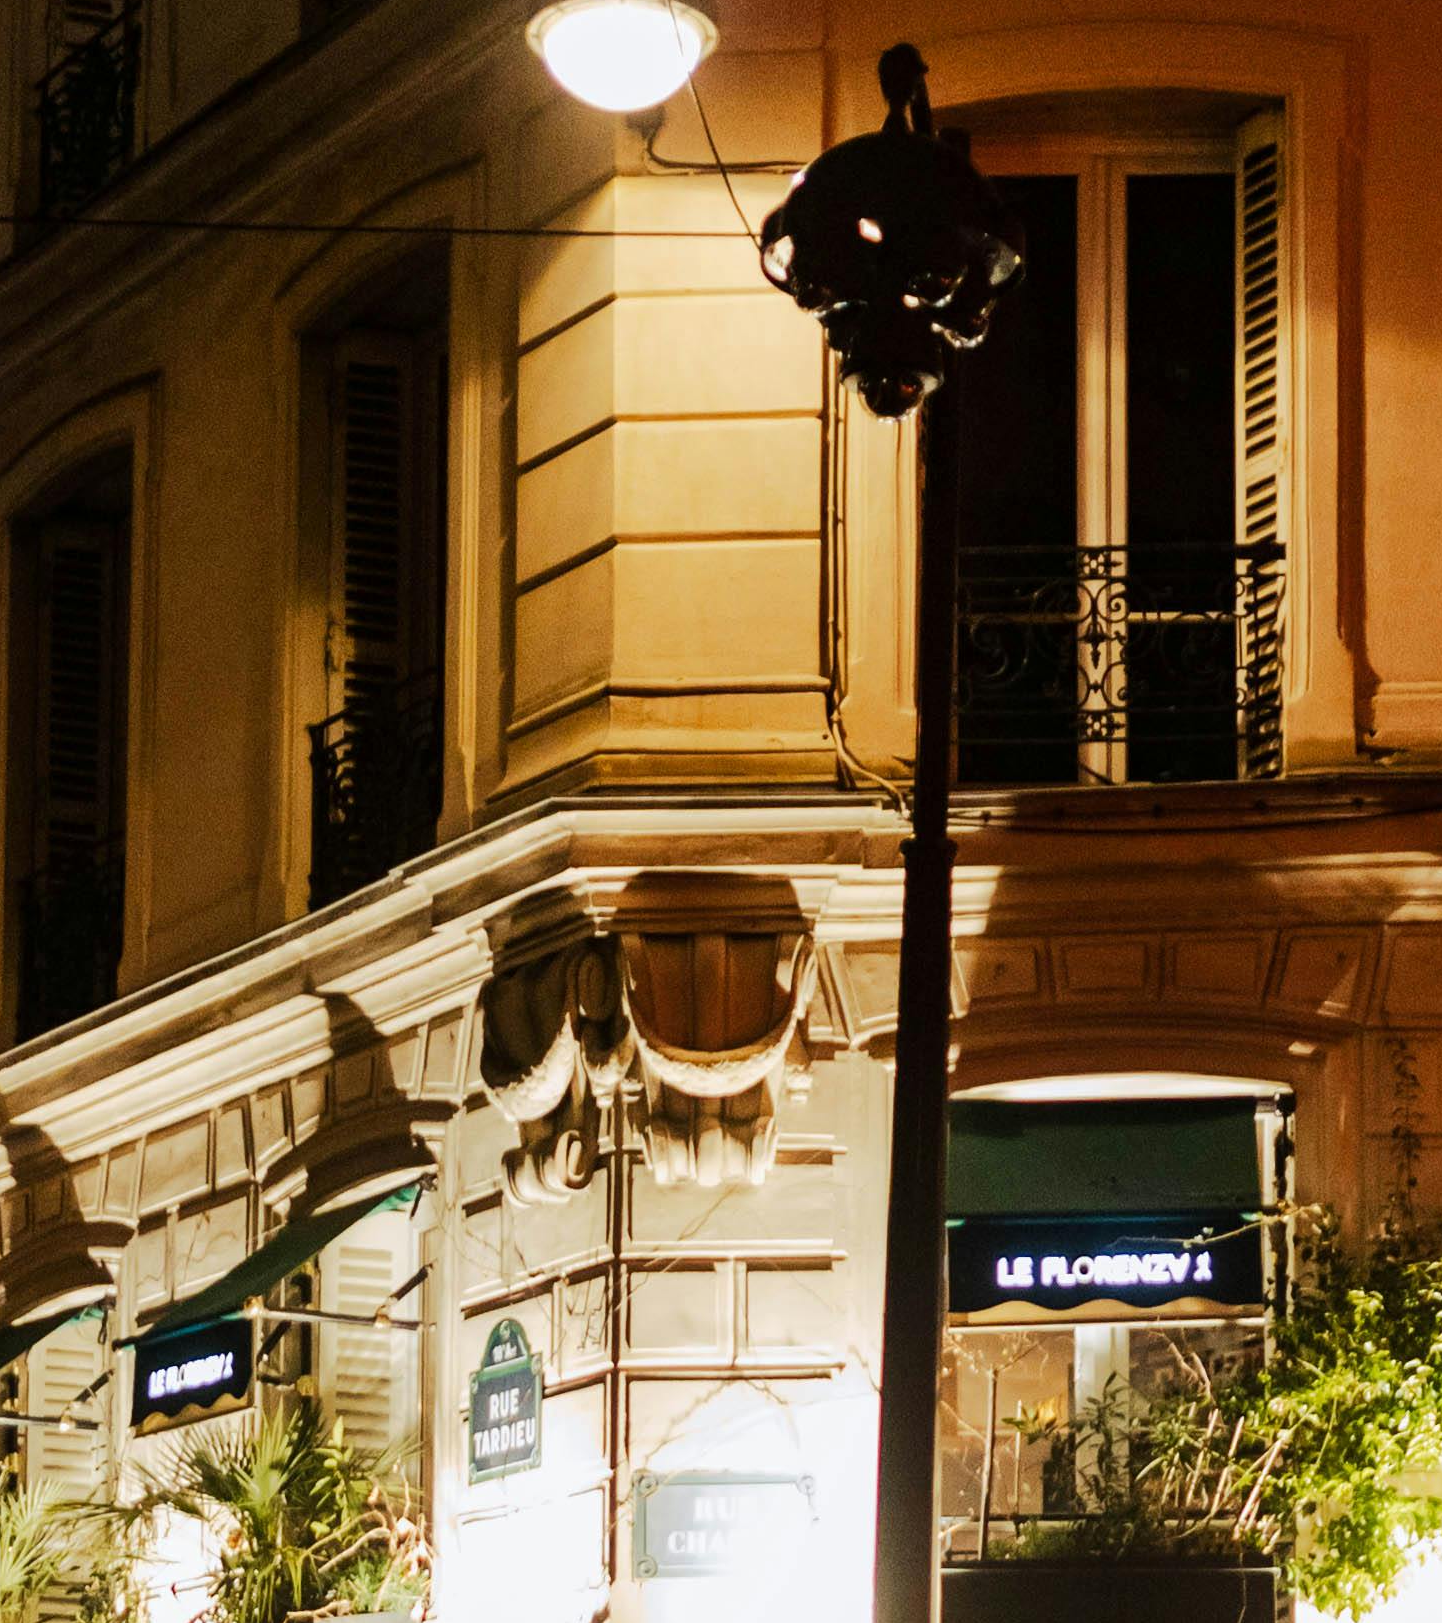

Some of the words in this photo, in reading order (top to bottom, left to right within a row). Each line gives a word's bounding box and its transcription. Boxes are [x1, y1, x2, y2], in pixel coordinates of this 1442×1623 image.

[996, 1255, 1034, 1287] LE
[489, 1387, 520, 1420] RUE
[474, 1417, 536, 1458] TARDIEU
